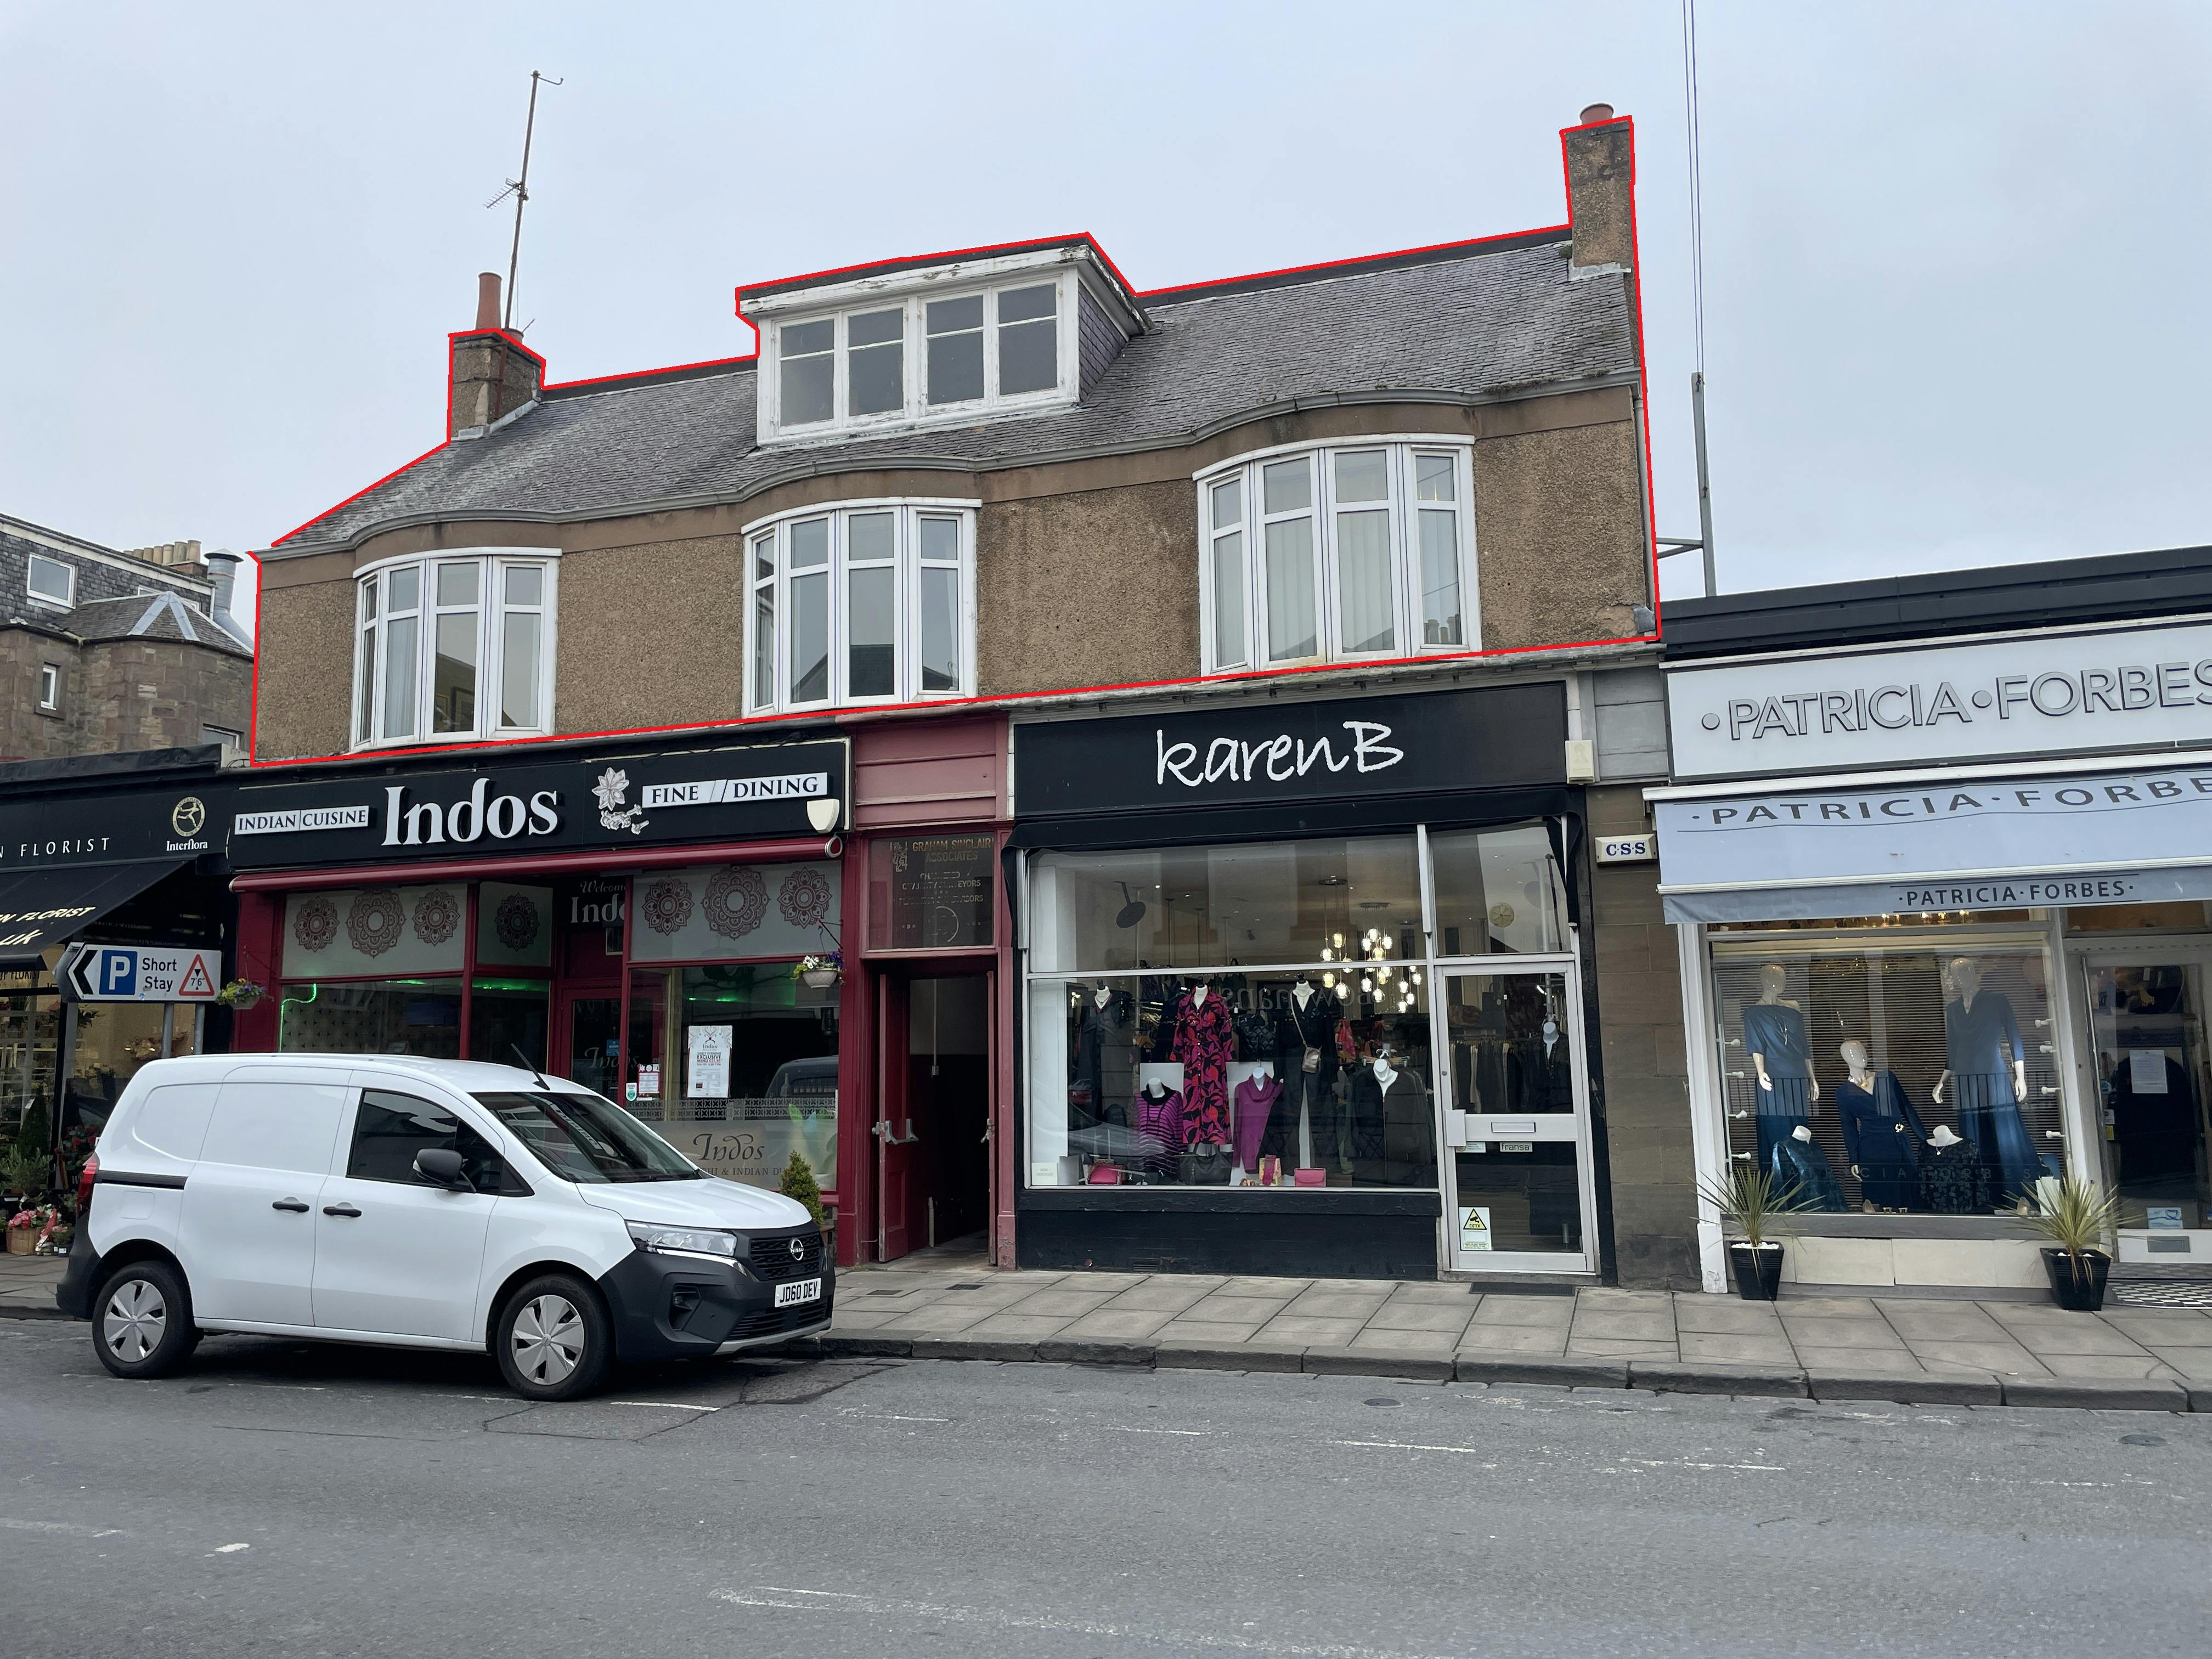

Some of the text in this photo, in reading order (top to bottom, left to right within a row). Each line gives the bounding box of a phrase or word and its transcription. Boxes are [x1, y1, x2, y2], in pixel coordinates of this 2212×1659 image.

[1728, 659, 2212, 741] PATRICIA FORBES
[651, 777, 818, 804] FINE DINING
[381, 778, 558, 846] Indos
[1712, 794, 1983, 824] PATRICIA
[238, 810, 366, 831] INDIAN CUISINE
[20, 837, 111, 857] FLORIST
[166, 838, 208, 851] Interflora
[912, 838, 991, 852] GRAHAM SINCLAIR
[580, 881, 625, 893] Welcom
[1906, 881, 2125, 906] PATRICIA FORBES
[16, 907, 96, 922] FLORIST
[571, 893, 625, 923] Ind
[109, 956, 131, 990] P
[142, 957, 177, 972] Short
[145, 976, 173, 992] Stay
[693, 1133, 765, 1161] Indos
[1502, 1141, 1530, 1151] fransa
[733, 1167, 769, 1176] INDIAN
[780, 1281, 818, 1304] JD60 DEV
